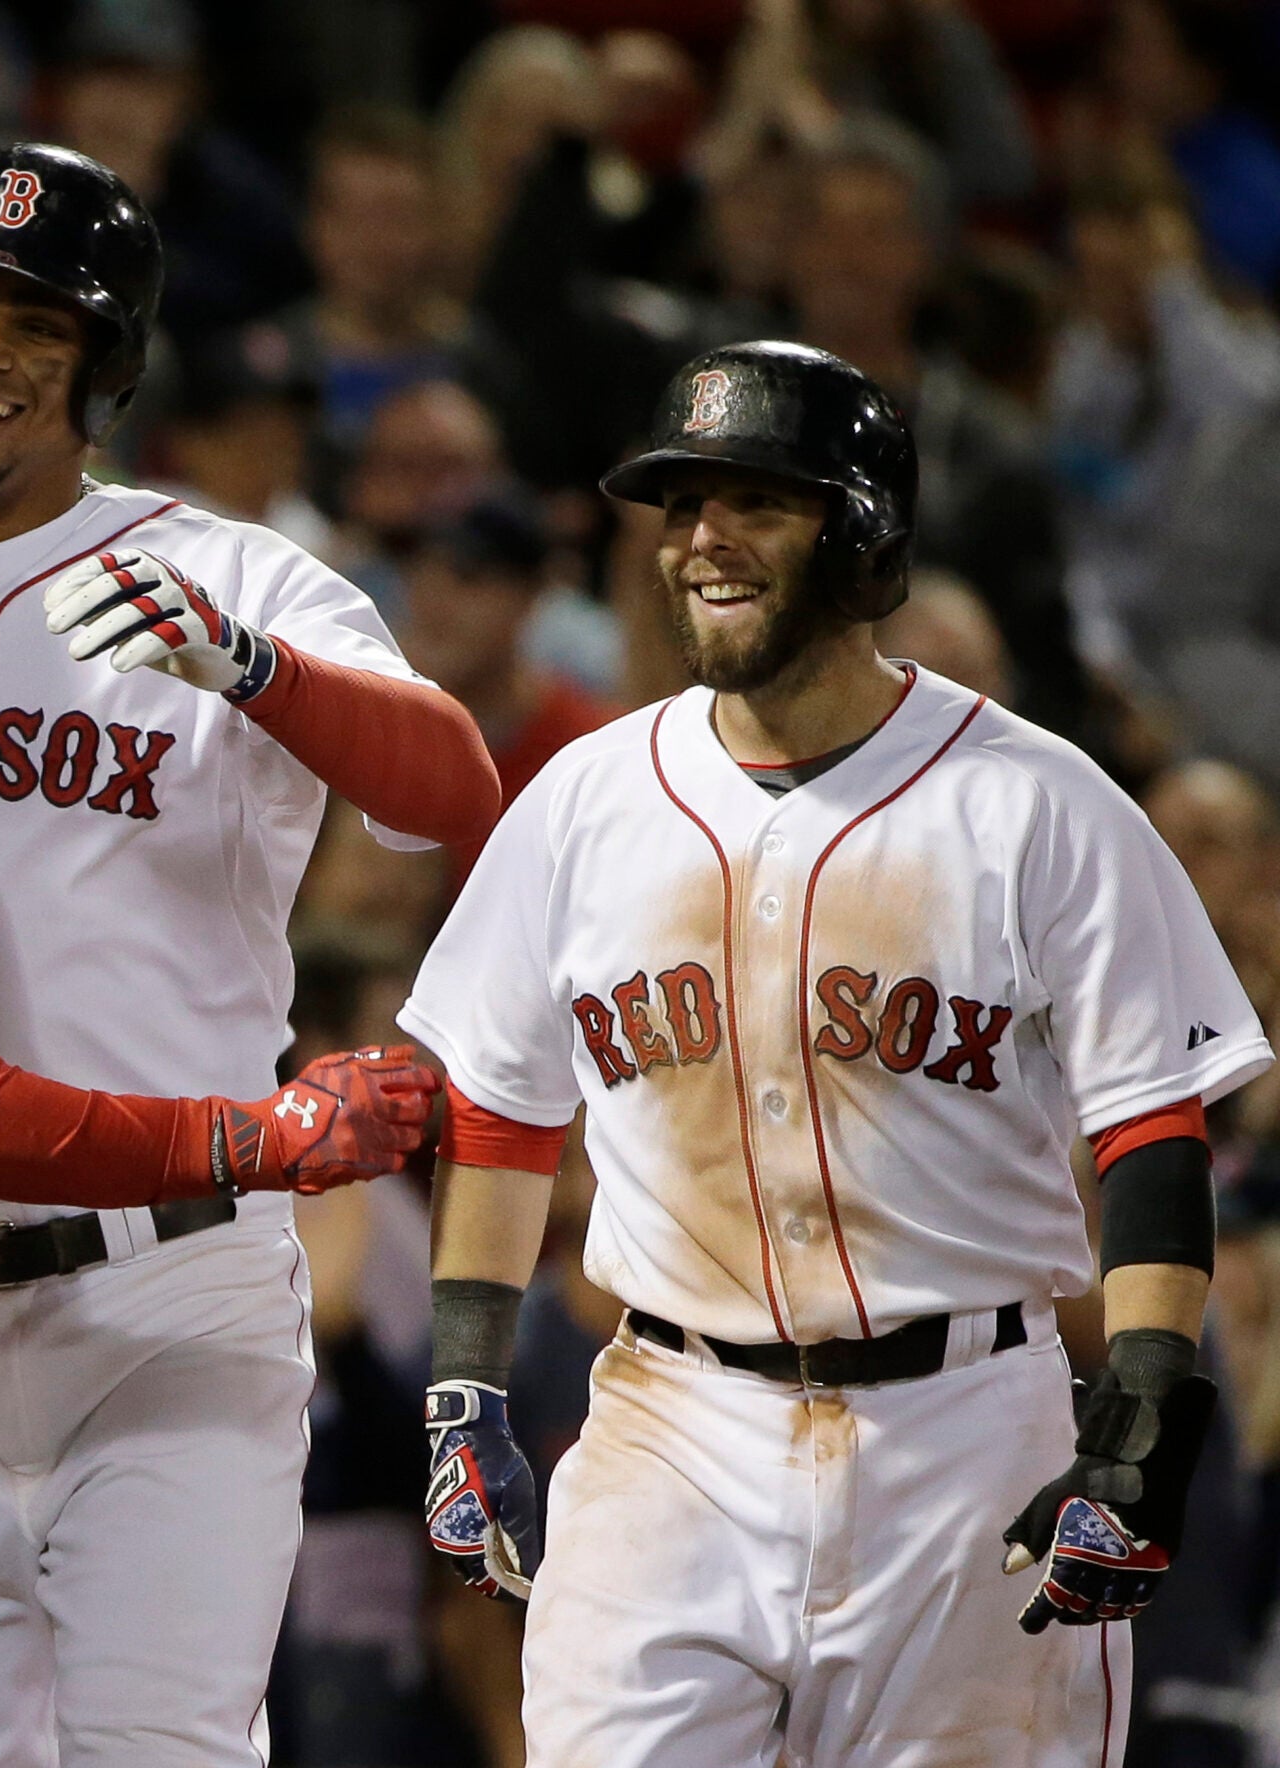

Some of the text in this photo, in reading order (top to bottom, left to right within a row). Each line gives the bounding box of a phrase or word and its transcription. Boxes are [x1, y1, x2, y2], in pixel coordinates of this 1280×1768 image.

[684, 370, 732, 431] B
[572, 961, 1013, 1092] RED SOX
